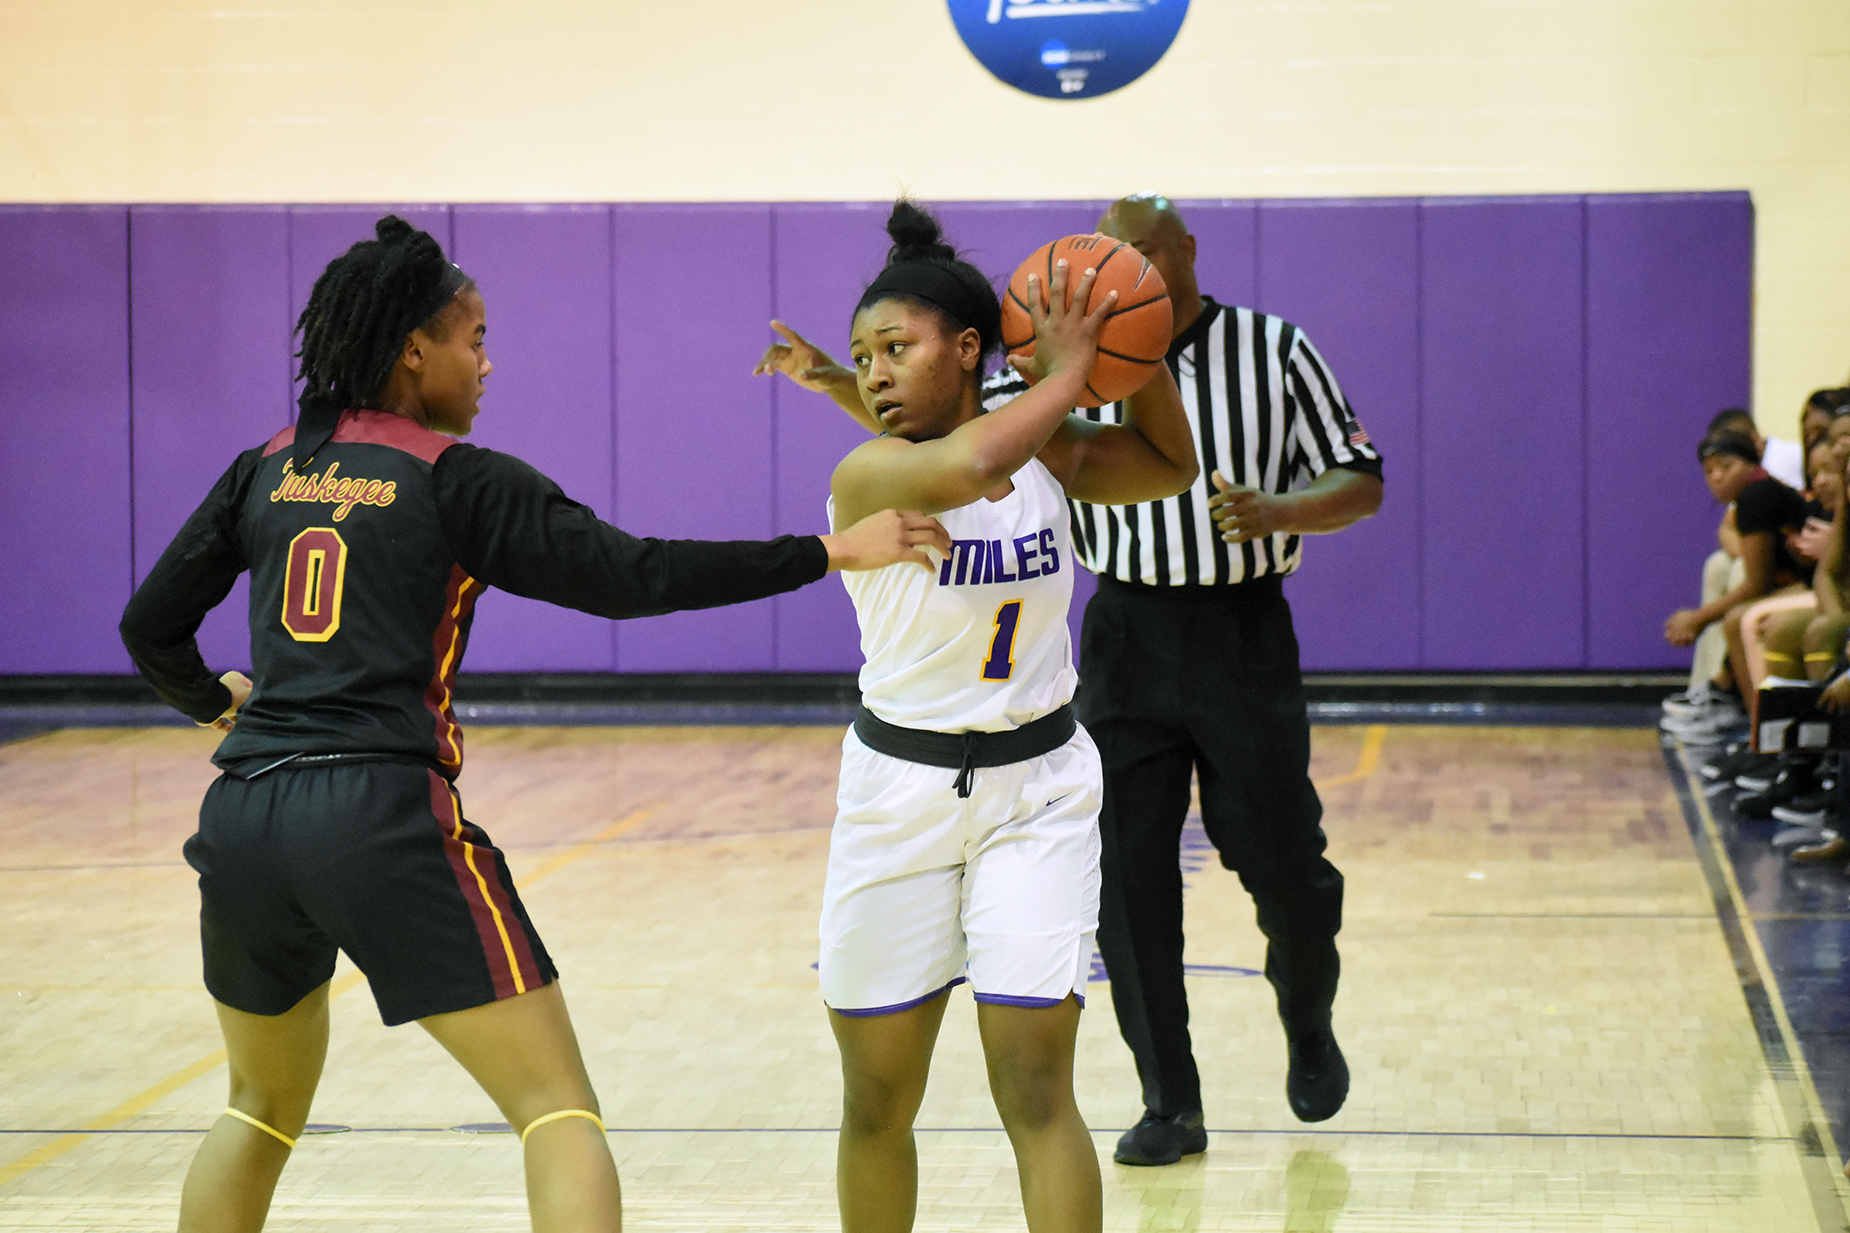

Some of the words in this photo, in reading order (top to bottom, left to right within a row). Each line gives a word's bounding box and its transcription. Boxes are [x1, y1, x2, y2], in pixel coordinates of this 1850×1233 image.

[281, 527, 348, 642] 0
[939, 528, 1060, 586] MILES
[979, 598, 1024, 682] 1
